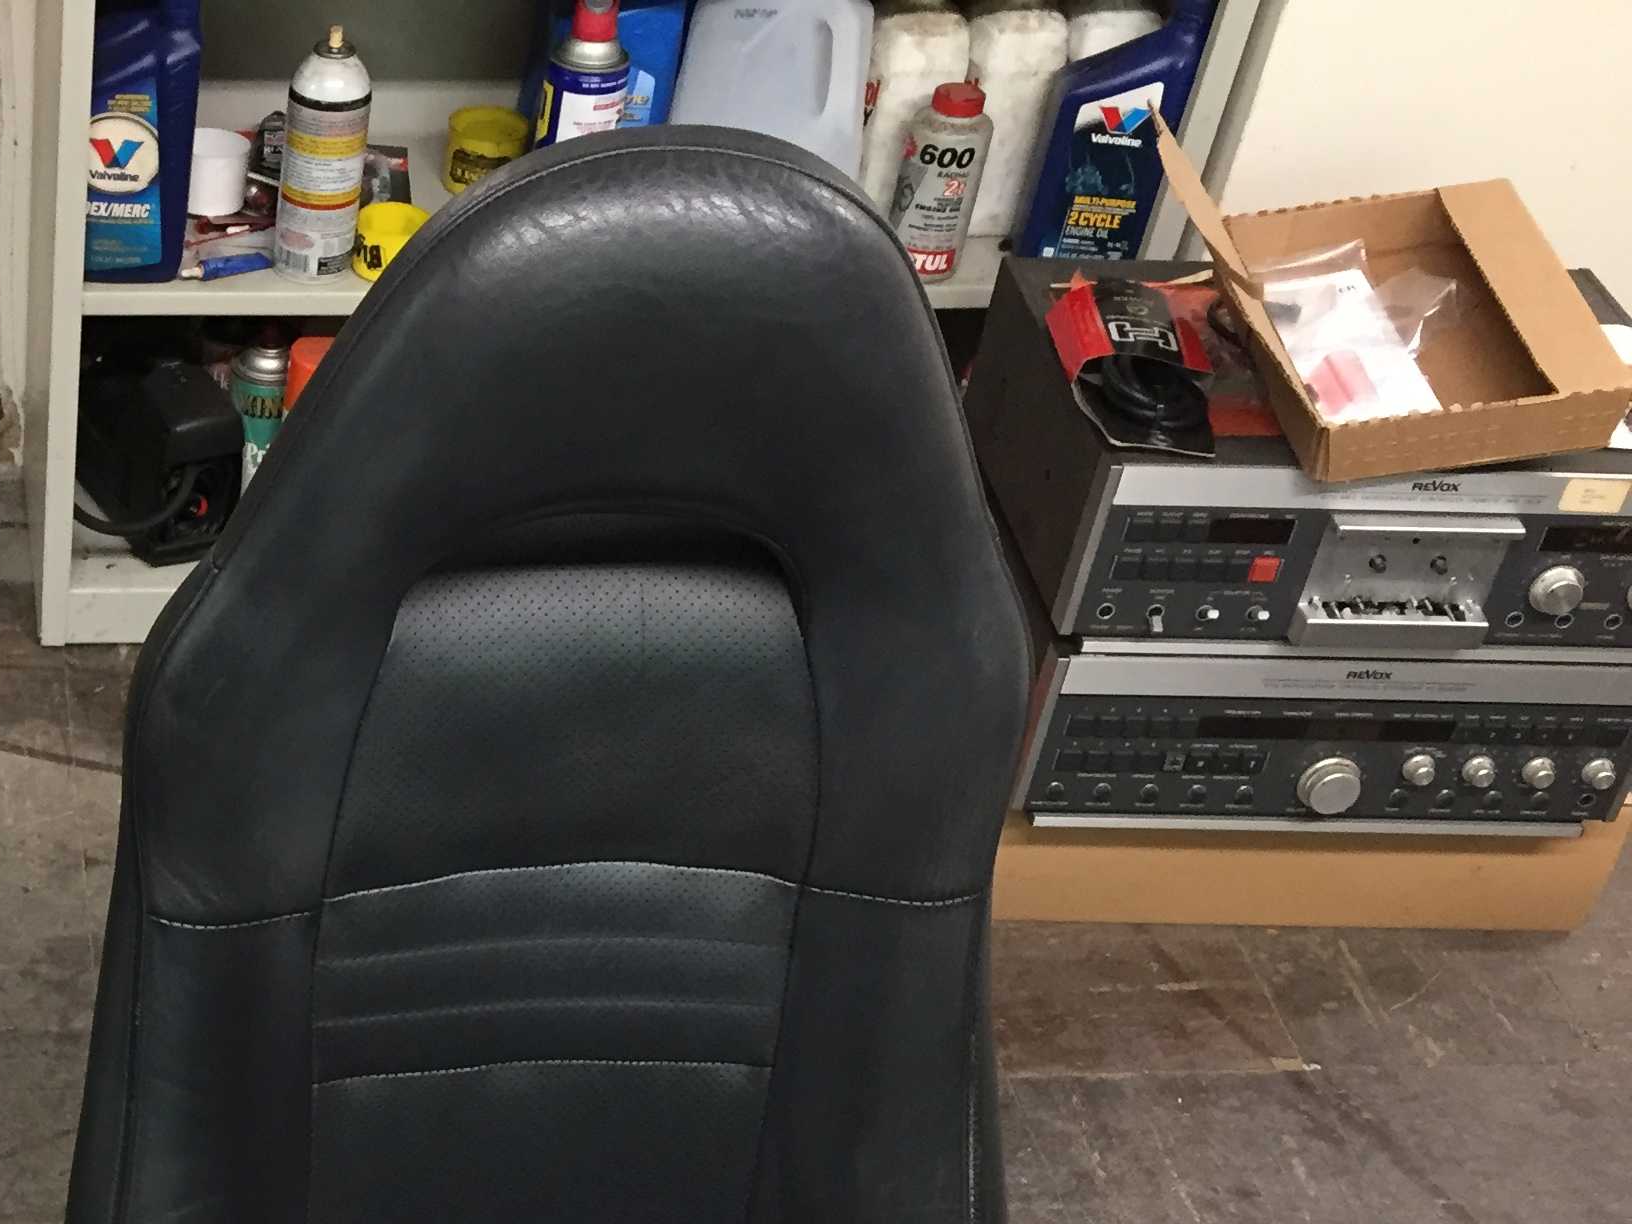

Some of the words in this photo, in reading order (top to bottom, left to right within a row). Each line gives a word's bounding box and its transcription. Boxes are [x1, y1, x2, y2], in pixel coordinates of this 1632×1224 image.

[1090, 132, 1143, 148] Valvoline
[919, 144, 976, 169] 600
[89, 169, 140, 182] Valvoline
[87, 201, 151, 218] EX/MERC
[1068, 211, 1078, 225] 2
[1079, 212, 1122, 228] CYCLE
[1065, 225, 1095, 238] ENGINE
[912, 253, 949, 271] TUL
